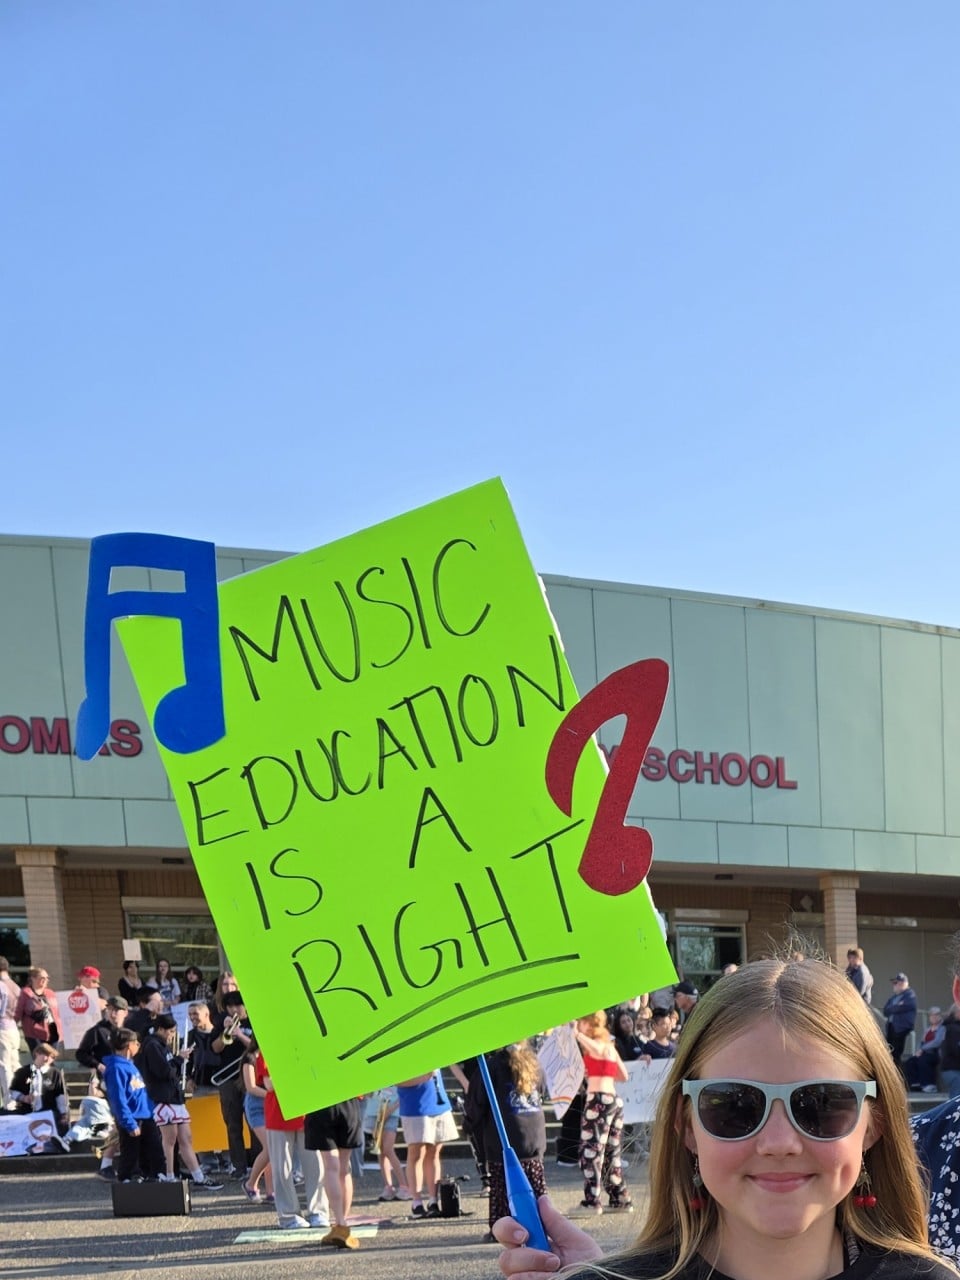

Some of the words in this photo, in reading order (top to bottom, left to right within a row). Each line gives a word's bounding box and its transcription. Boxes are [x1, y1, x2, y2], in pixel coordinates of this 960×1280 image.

[228, 538, 492, 702] MUSIC
[0, 714, 143, 758] OMS
[641, 746, 798, 790] SCHOOL
[186, 634, 566, 847] EDUCATION
[245, 848, 323, 930] IS
[408, 786, 473, 869] A
[291, 818, 586, 1037] RIGHT
[70, 996, 89, 1009] STOP
